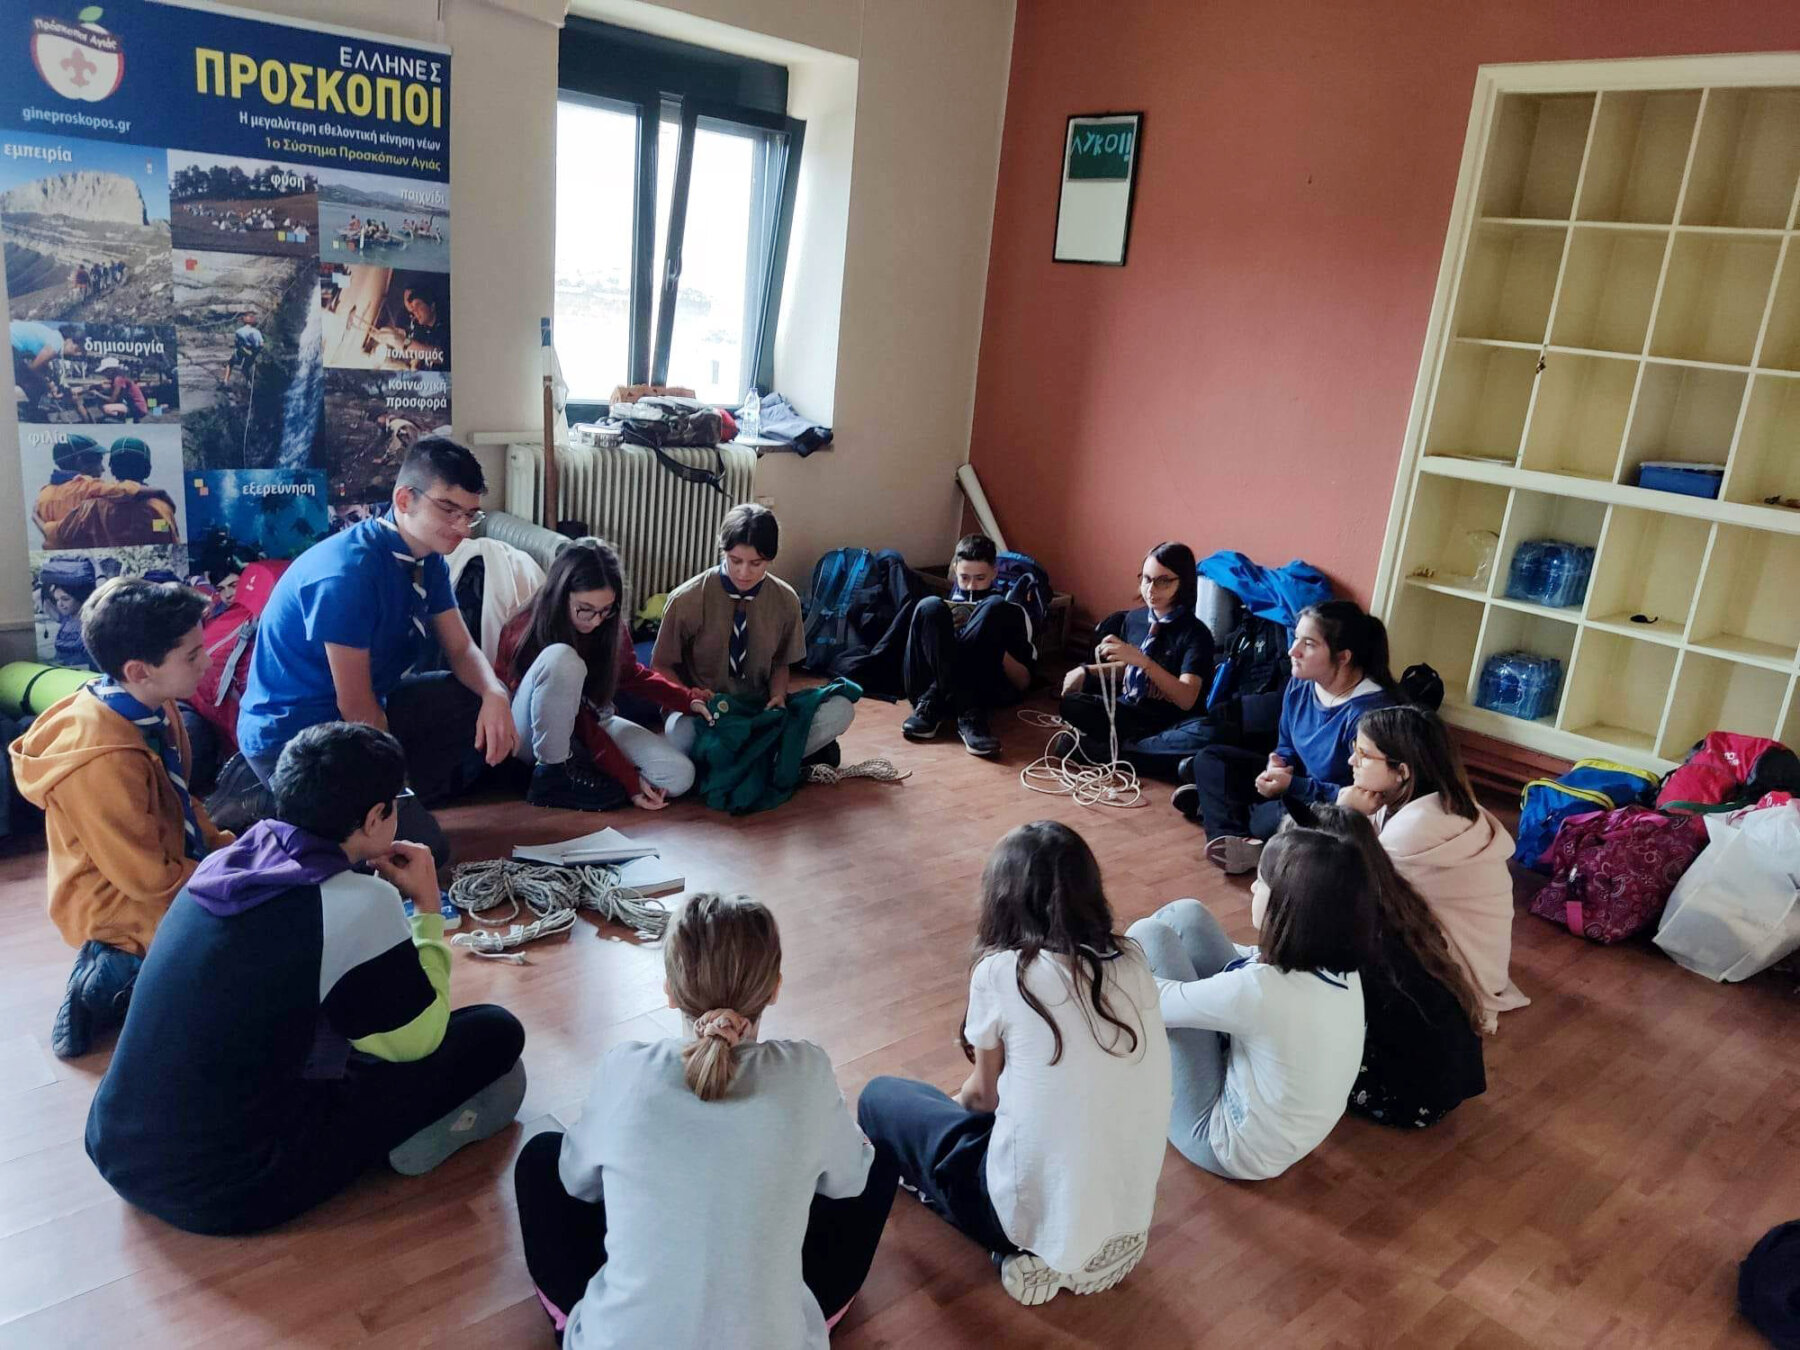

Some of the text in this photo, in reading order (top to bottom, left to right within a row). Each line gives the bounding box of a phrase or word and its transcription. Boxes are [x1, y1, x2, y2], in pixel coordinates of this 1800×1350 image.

[340, 46, 442, 83] ΕΛΛΗΝΕΣ
[195, 47, 442, 128] ΠΡΟΣΚΟΠΟΙ
[22, 106, 132, 133] gineproskopos.gr
[239, 111, 441, 151] Η μεγαλύτερη εθελοντική κίνηση νέων
[3, 143, 73, 163] εμπειρία
[283, 138, 337, 158] Σύστημα
[340, 145, 409, 166] Προσκόπων
[411, 156, 441, 171] Αγιάς
[270, 171, 306, 192] φύση
[401, 188, 445, 205] παιχνίδι
[84, 336, 165, 356] δημιουργία
[388, 378, 447, 394] κοινωνική
[386, 396, 447, 411] προσφορά
[28, 430, 69, 447] φιλία
[242, 481, 316, 497] εξερεύνηση
